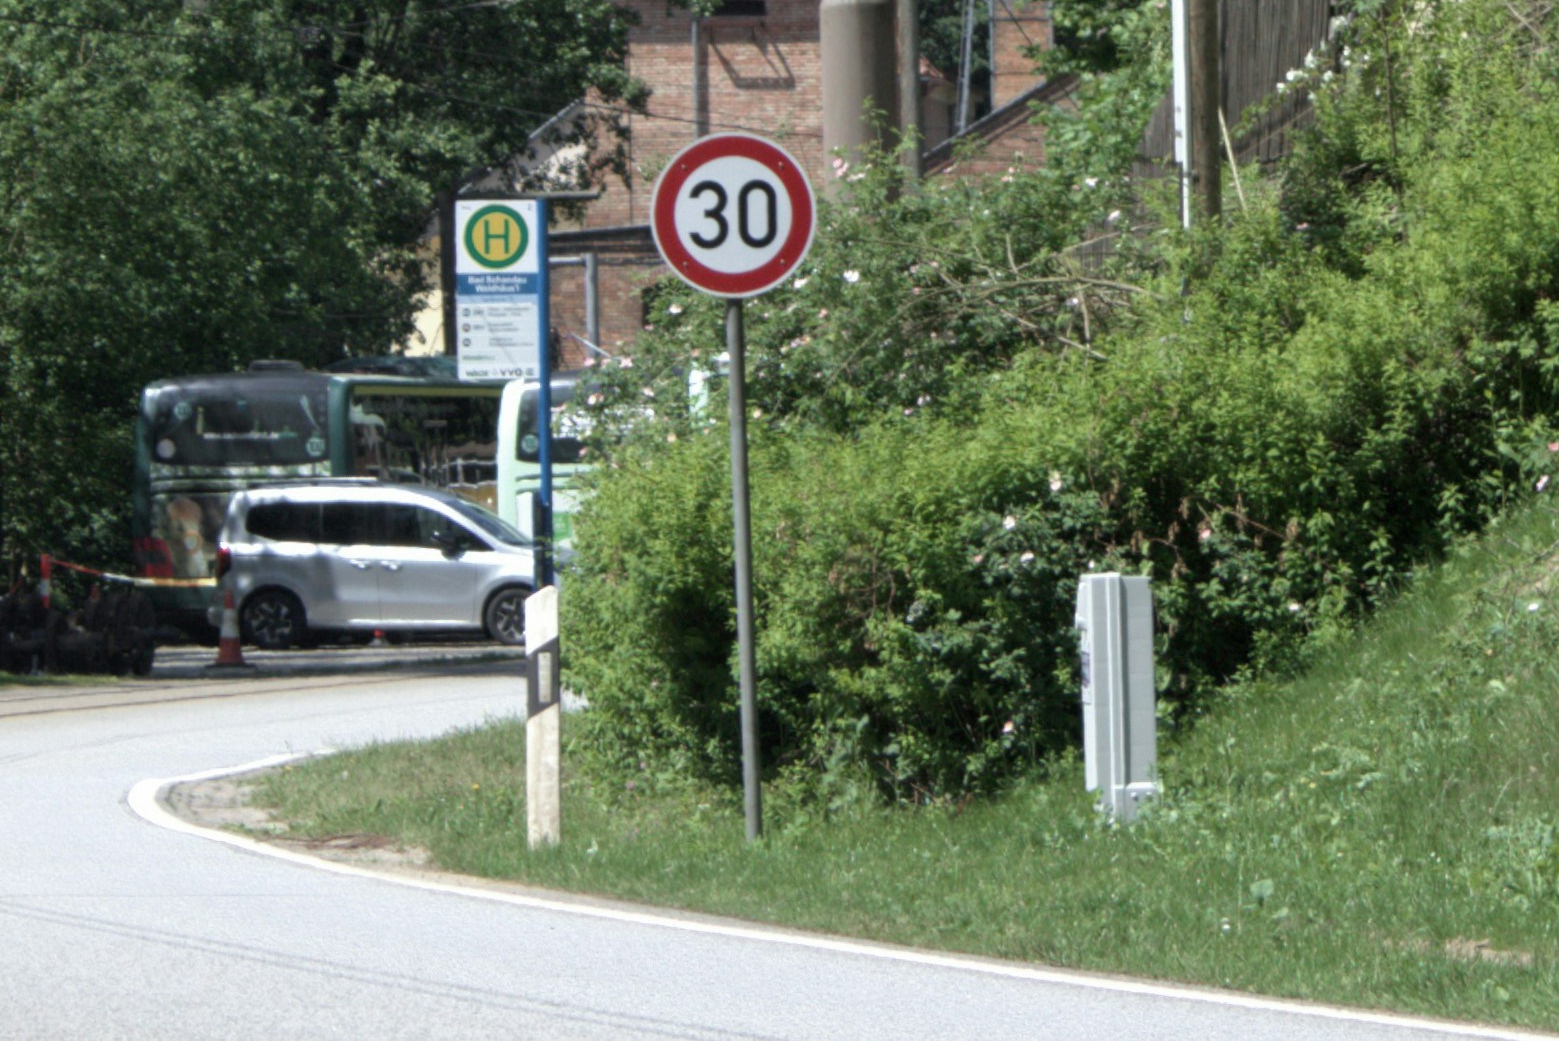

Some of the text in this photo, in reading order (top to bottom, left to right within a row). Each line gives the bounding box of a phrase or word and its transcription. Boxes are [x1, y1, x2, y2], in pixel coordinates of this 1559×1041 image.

[688, 179, 778, 250] 30
[483, 219, 510, 255] H
[468, 275, 528, 285] Bad Schandau
